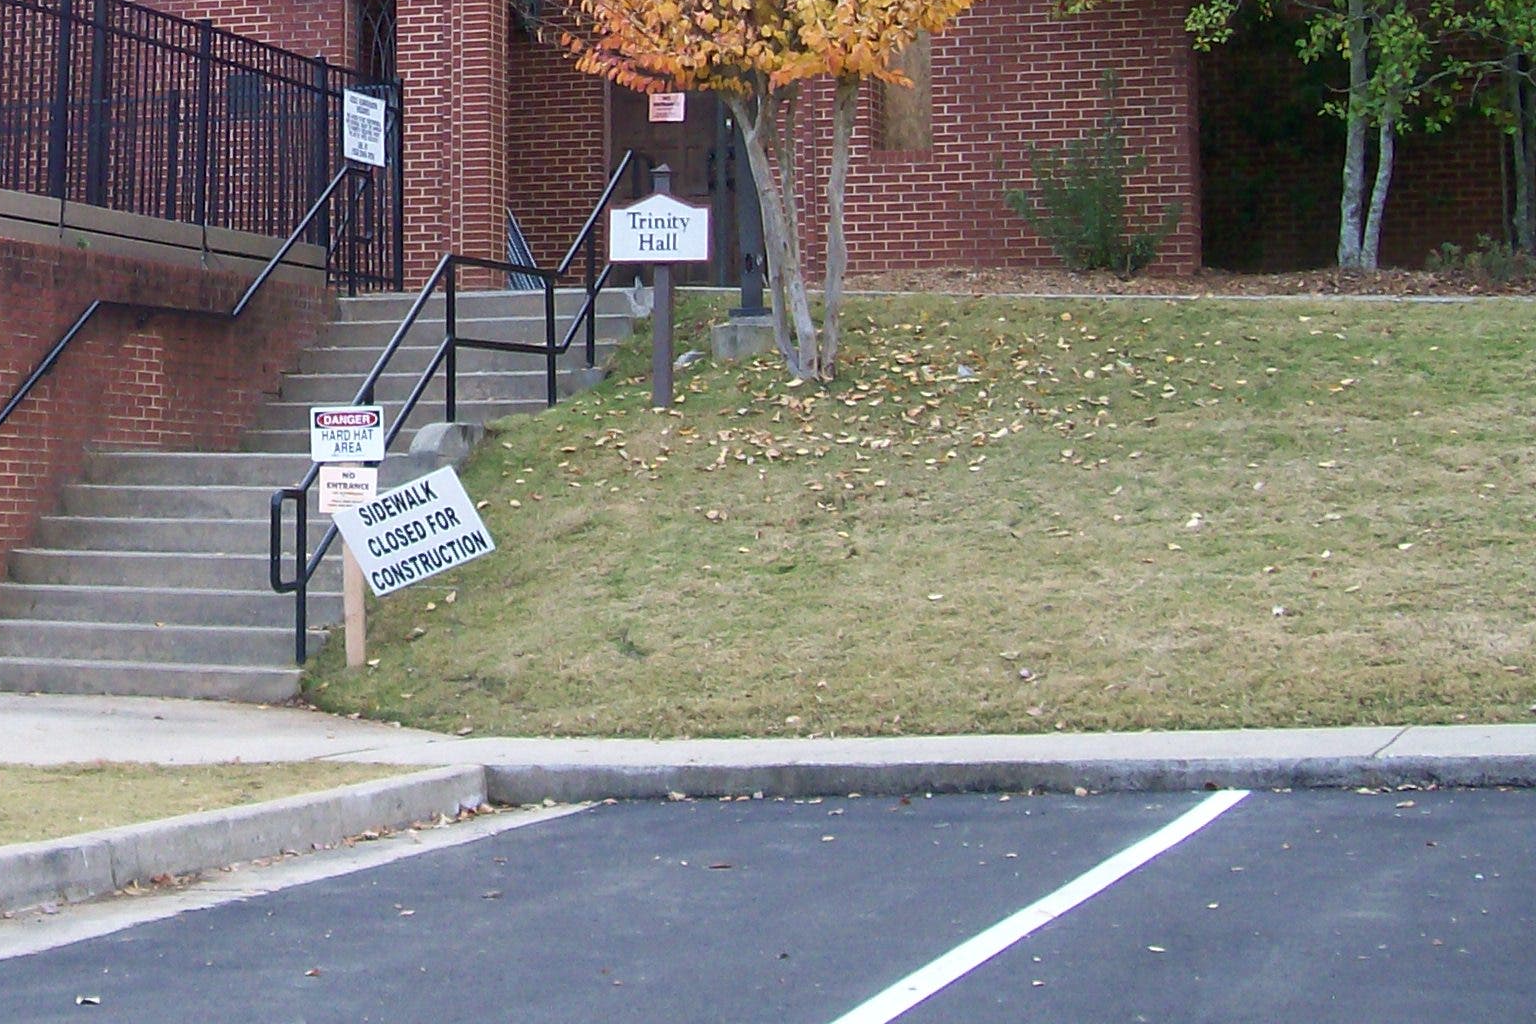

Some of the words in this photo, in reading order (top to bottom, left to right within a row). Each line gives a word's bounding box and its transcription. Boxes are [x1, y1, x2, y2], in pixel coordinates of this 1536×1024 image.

[626, 211, 690, 233] Trinity
[638, 233, 678, 251] Hall
[323, 414, 371, 426] DANGER
[321, 429, 351, 441] HARD
[353, 428, 374, 441] HAT
[333, 441, 362, 453] AREA
[358, 480, 438, 527] SIDEWALK
[367, 520, 427, 558] CLOSED
[425, 506, 461, 535] FOR
[371, 530, 488, 591] CONSTRUCTION
